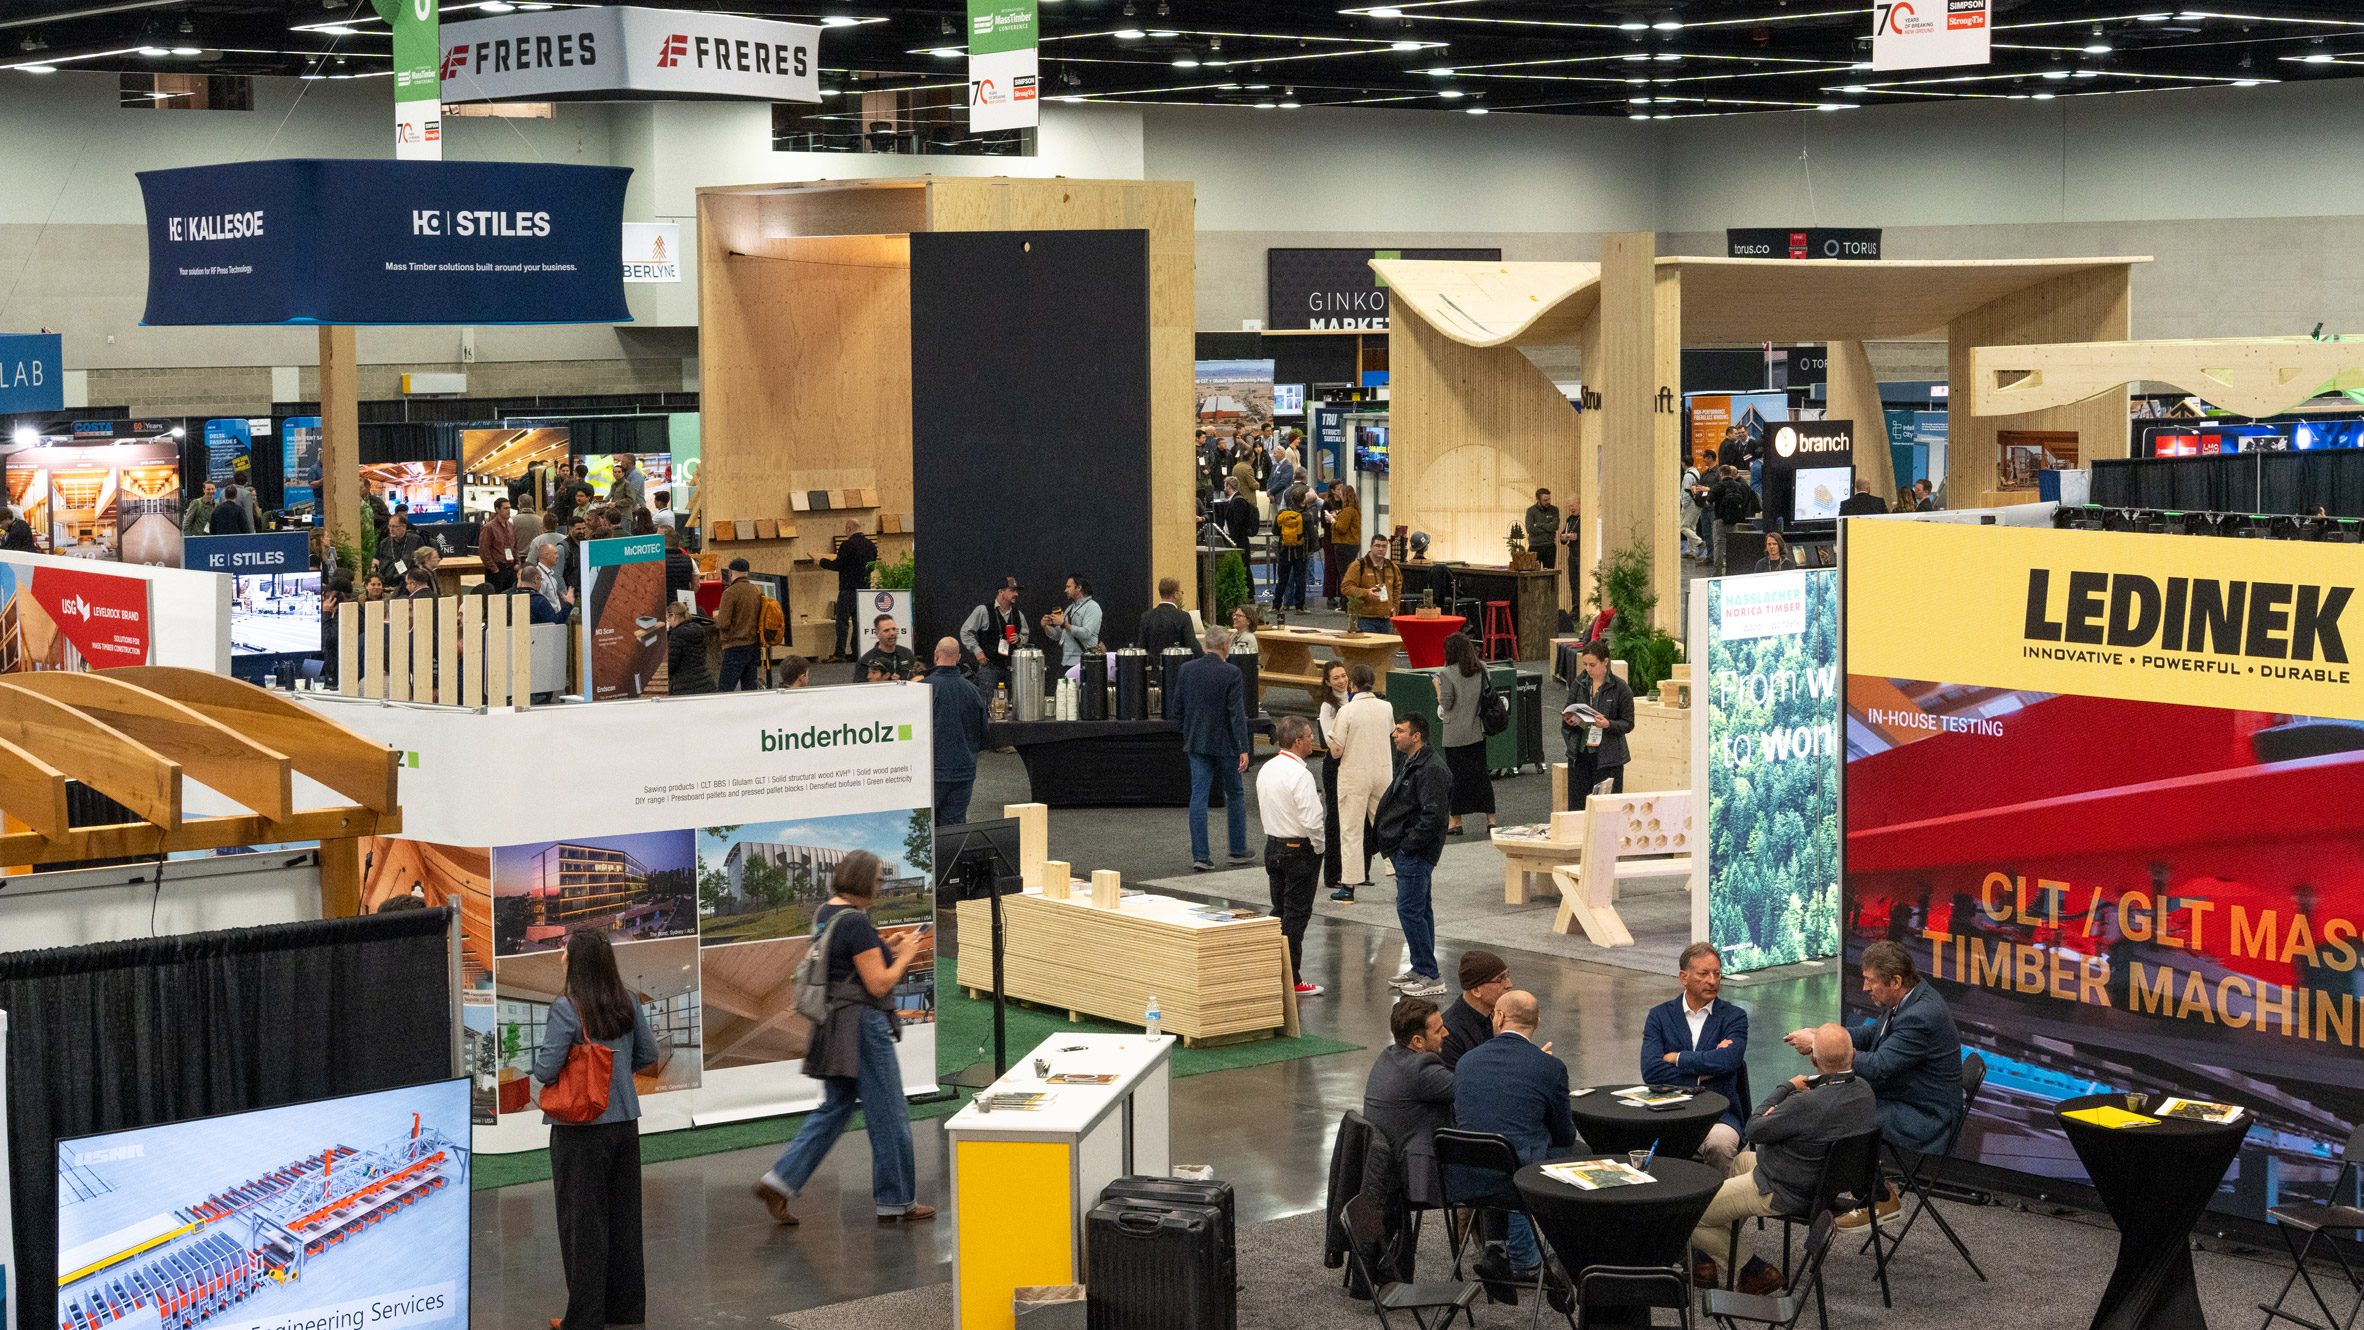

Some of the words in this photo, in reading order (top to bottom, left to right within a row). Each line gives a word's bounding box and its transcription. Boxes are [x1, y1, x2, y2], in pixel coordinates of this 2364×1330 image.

[1949, 0, 1984, 10] SIMPSON
[999, 24, 1028, 32] CONFERENCE
[1948, 16, 1984, 26] Strong-Tie
[476, 33, 596, 74] FRERES
[694, 36, 807, 77] FRERES
[189, 210, 264, 241] KALLESOE
[456, 211, 550, 237] STILES
[1734, 243, 1770, 254] torus.co
[1843, 241, 1877, 254] TORUS
[179, 268, 188, 276] Your
[188, 267, 204, 275] solution
[210, 266, 217, 274] RF
[216, 266, 229, 274] Press
[385, 262, 408, 271] Mass
[408, 262, 437, 271] Timber
[438, 262, 474, 271] solutions
[475, 262, 493, 271] built
[494, 263, 522, 271] around
[523, 264, 540, 273] your
[541, 262, 577, 271] business.
[73, 421, 113, 432] COSTA
[145, 422, 163, 430] Years
[1799, 432, 1849, 453] branch
[233, 551, 285, 567] STILES
[62, 598, 77, 615] USG
[1725, 589, 1800, 607] HASSLACHER
[93, 606, 121, 619] LEVELROCK
[121, 610, 139, 621] BRAND
[1725, 605, 1762, 618] NORICA
[1766, 602, 1801, 615] TIMBER
[2023, 568, 2355, 665] LEDINEK
[2023, 646, 2123, 665] INNOVATIVE
[2142, 655, 2241, 674] POWERFUL
[2260, 665, 2350, 684] DURABLE
[1720, 669, 1796, 709] From
[1868, 708, 1937, 730] IN-HOUSE
[1940, 715, 2004, 737] TESTING
[761, 721, 894, 752] binderholz
[1723, 730, 1752, 768] to
[635, 797, 646, 805] DIY
[647, 796, 666, 805] range
[671, 792, 705, 802] Pressboard
[706, 790, 727, 801] pallets
[727, 788, 740, 797] and
[741, 787, 765, 798] pressed
[766, 785, 783, 795] pallet
[784, 783, 804, 793] blocks
[809, 781, 837, 790] Densified
[838, 778, 862, 788] biofuels
[866, 776, 884, 786] Green
[885, 774, 912, 784] electricity
[643, 785, 667, 795] Sawing
[668, 782, 695, 793] products
[700, 781, 712, 789] CLT
[713, 780, 727, 788] BBS
[732, 778, 753, 787] Glulam
[754, 777, 766, 785] GLT
[771, 775, 787, 784] Solid
[788, 773, 817, 782] structural
[817, 771, 834, 779] wood
[856, 768, 872, 777] Solid
[872, 766, 889, 775] wood
[890, 764, 909, 775] panels
[1981, 871, 2071, 930] CLT
[2082, 886, 2103, 938] /
[2117, 890, 2215, 951] GLT
[2230, 904, 2364, 973] MAS
[1922, 929, 2112, 1008] TIMBER
[2129, 961, 2364, 1050] MACHIN
[371, 1293, 445, 1322] Services
